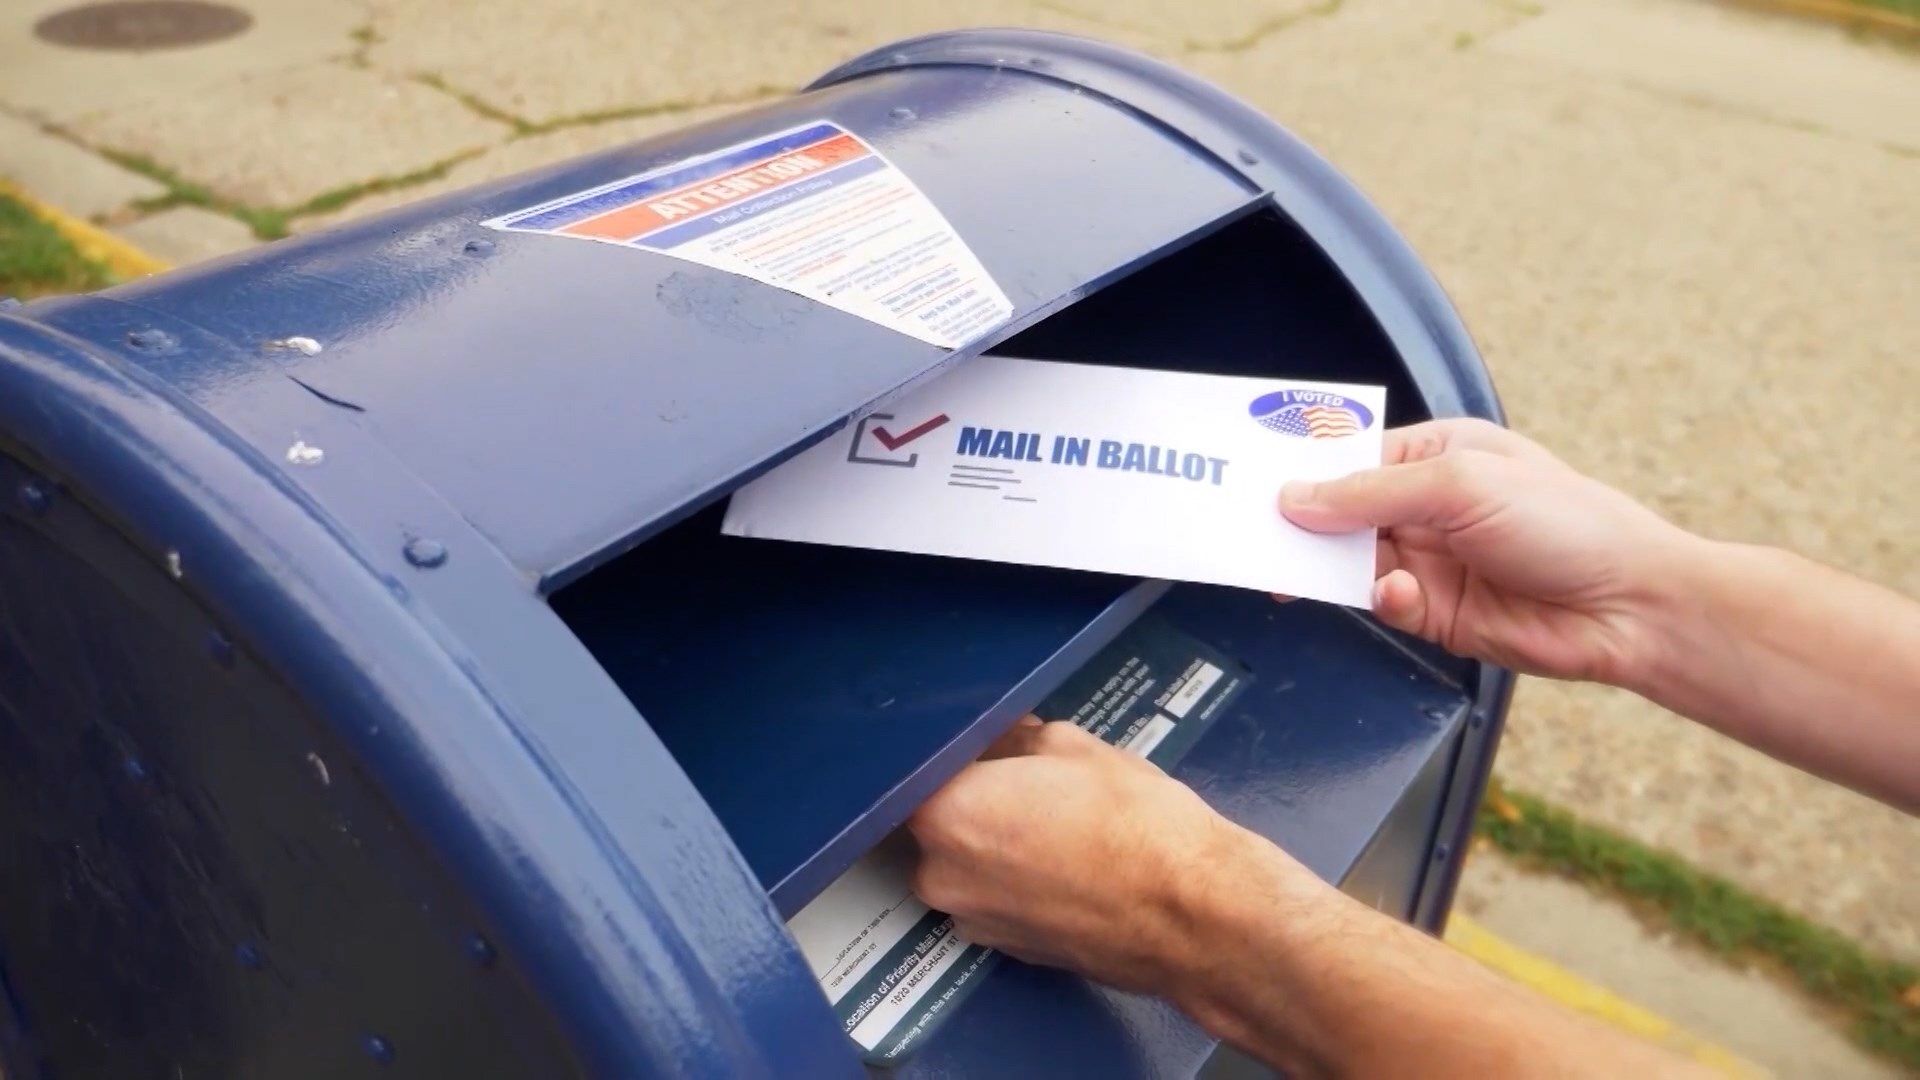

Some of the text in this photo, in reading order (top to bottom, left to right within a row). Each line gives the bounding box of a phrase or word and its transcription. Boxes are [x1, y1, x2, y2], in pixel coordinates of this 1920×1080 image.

[649, 154, 826, 219] ATTENTION
[1281, 390, 1346, 407] I VOTED
[956, 426, 1230, 486] MAIL IN BALLOT
[878, 979, 890, 994] of
[885, 952, 921, 985] Priority
[889, 986, 911, 1007] 1020
[906, 944, 949, 988] MERCHANT
